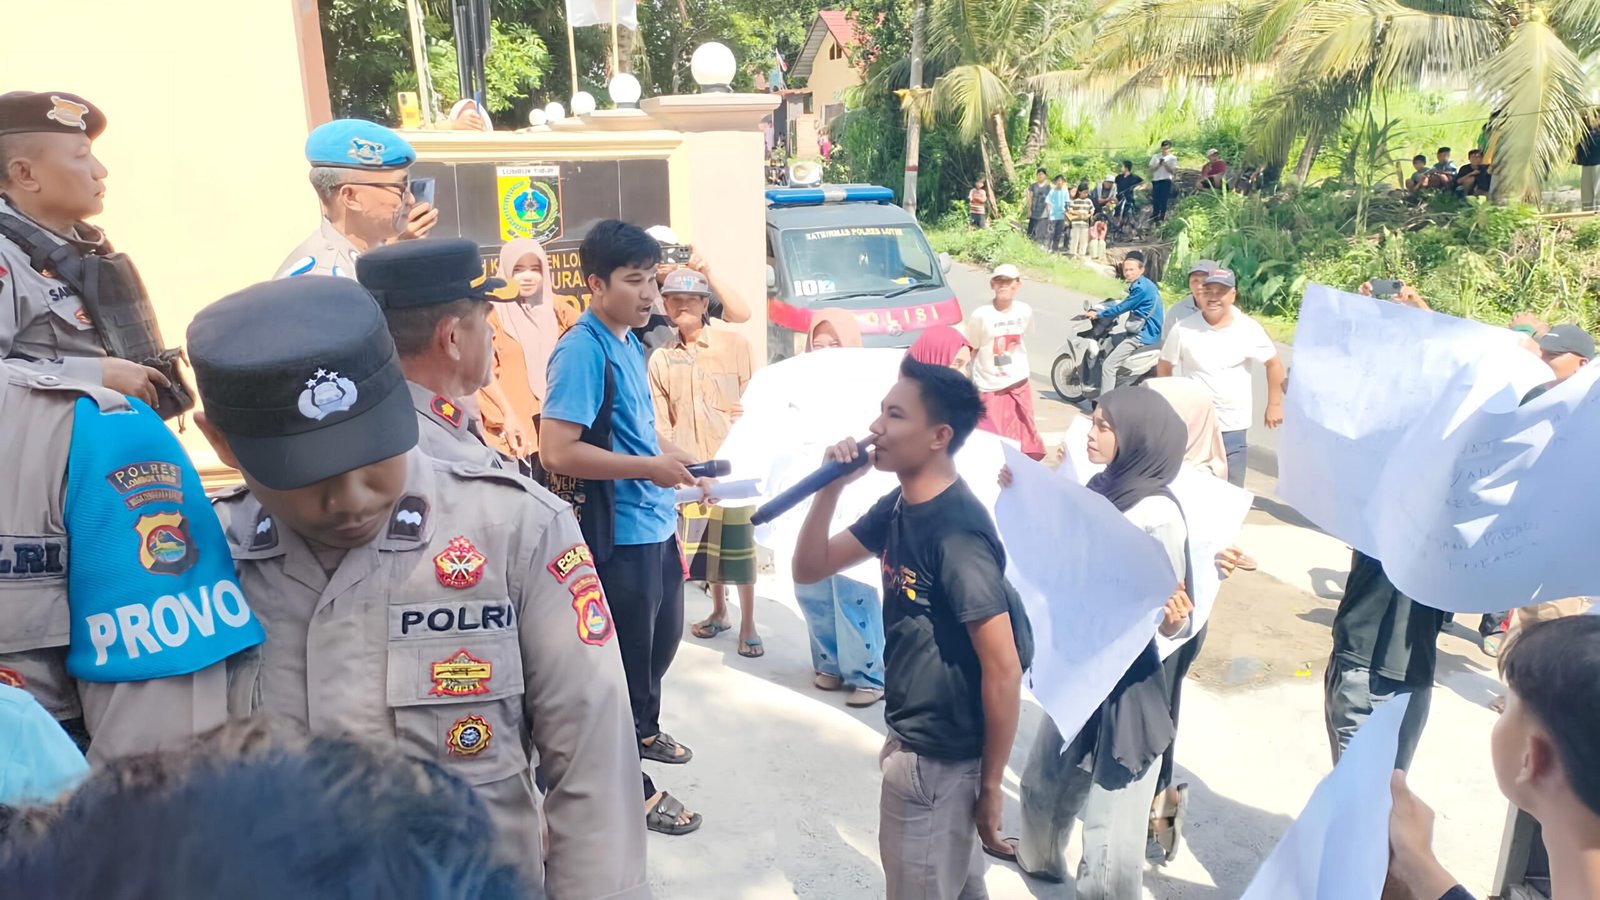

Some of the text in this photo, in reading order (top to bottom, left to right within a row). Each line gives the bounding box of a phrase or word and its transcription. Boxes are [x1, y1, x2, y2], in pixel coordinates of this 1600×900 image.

[853, 300, 939, 326] OLISI
[115, 464, 177, 483] POLRES
[85, 579, 250, 665] PROVO
[402, 604, 513, 634] POLRI
